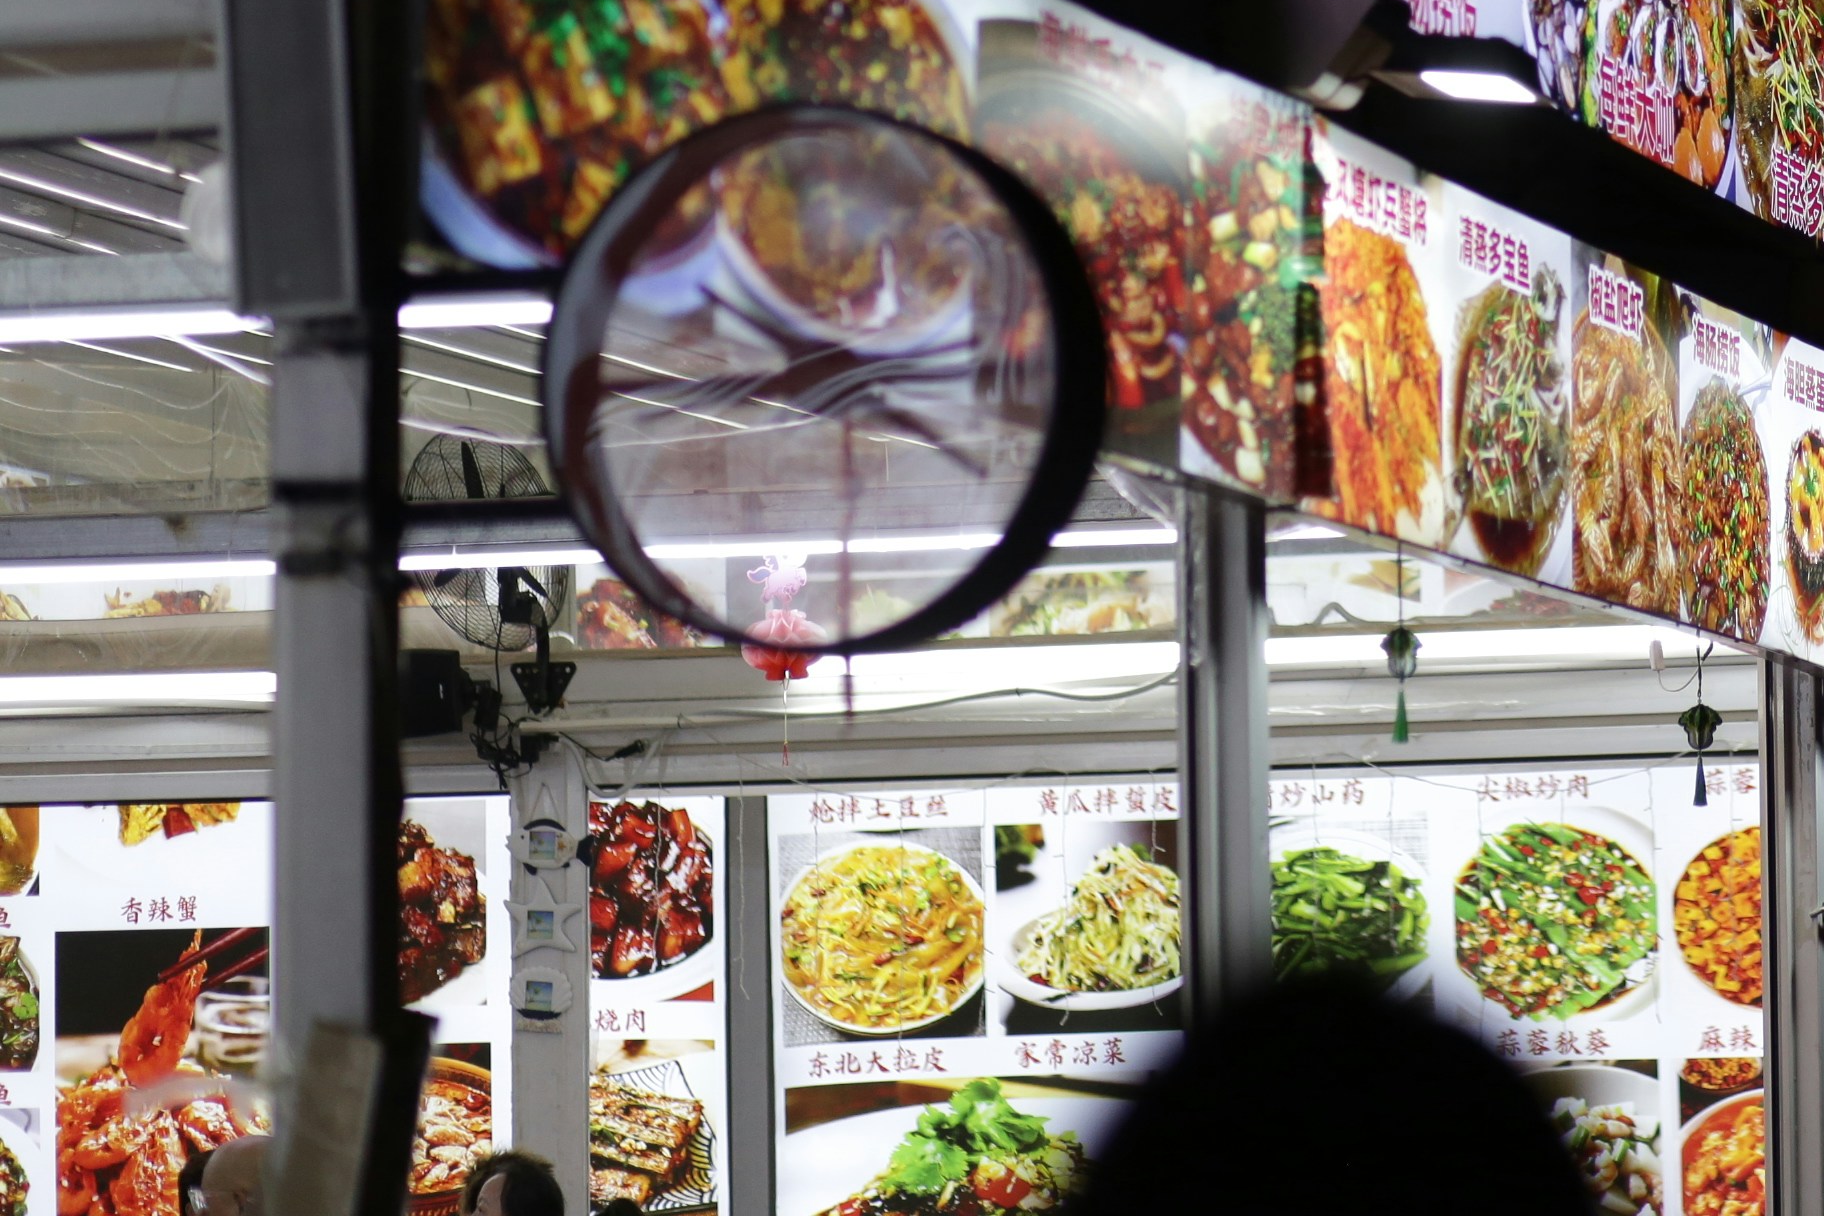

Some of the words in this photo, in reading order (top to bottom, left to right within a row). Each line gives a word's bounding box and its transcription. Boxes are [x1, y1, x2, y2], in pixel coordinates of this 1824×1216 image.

[1598, 55, 1675, 165] 海鲜大咖
[1459, 216, 1531, 293] 清蒸多宝鱼
[1589, 265, 1643, 339] 椒盐爬虾
[1692, 313, 1741, 380] 海肠捞饭
[1477, 772, 1590, 801] 尖椒炒肉
[119, 895, 198, 924] 香辣蟹
[593, 1010, 646, 1034] 烧肉
[1698, 1024, 1763, 1052] 麻辣
[808, 1044, 947, 1076] 东北大拉皮
[1014, 1036, 1126, 1069] 家常凉菜
